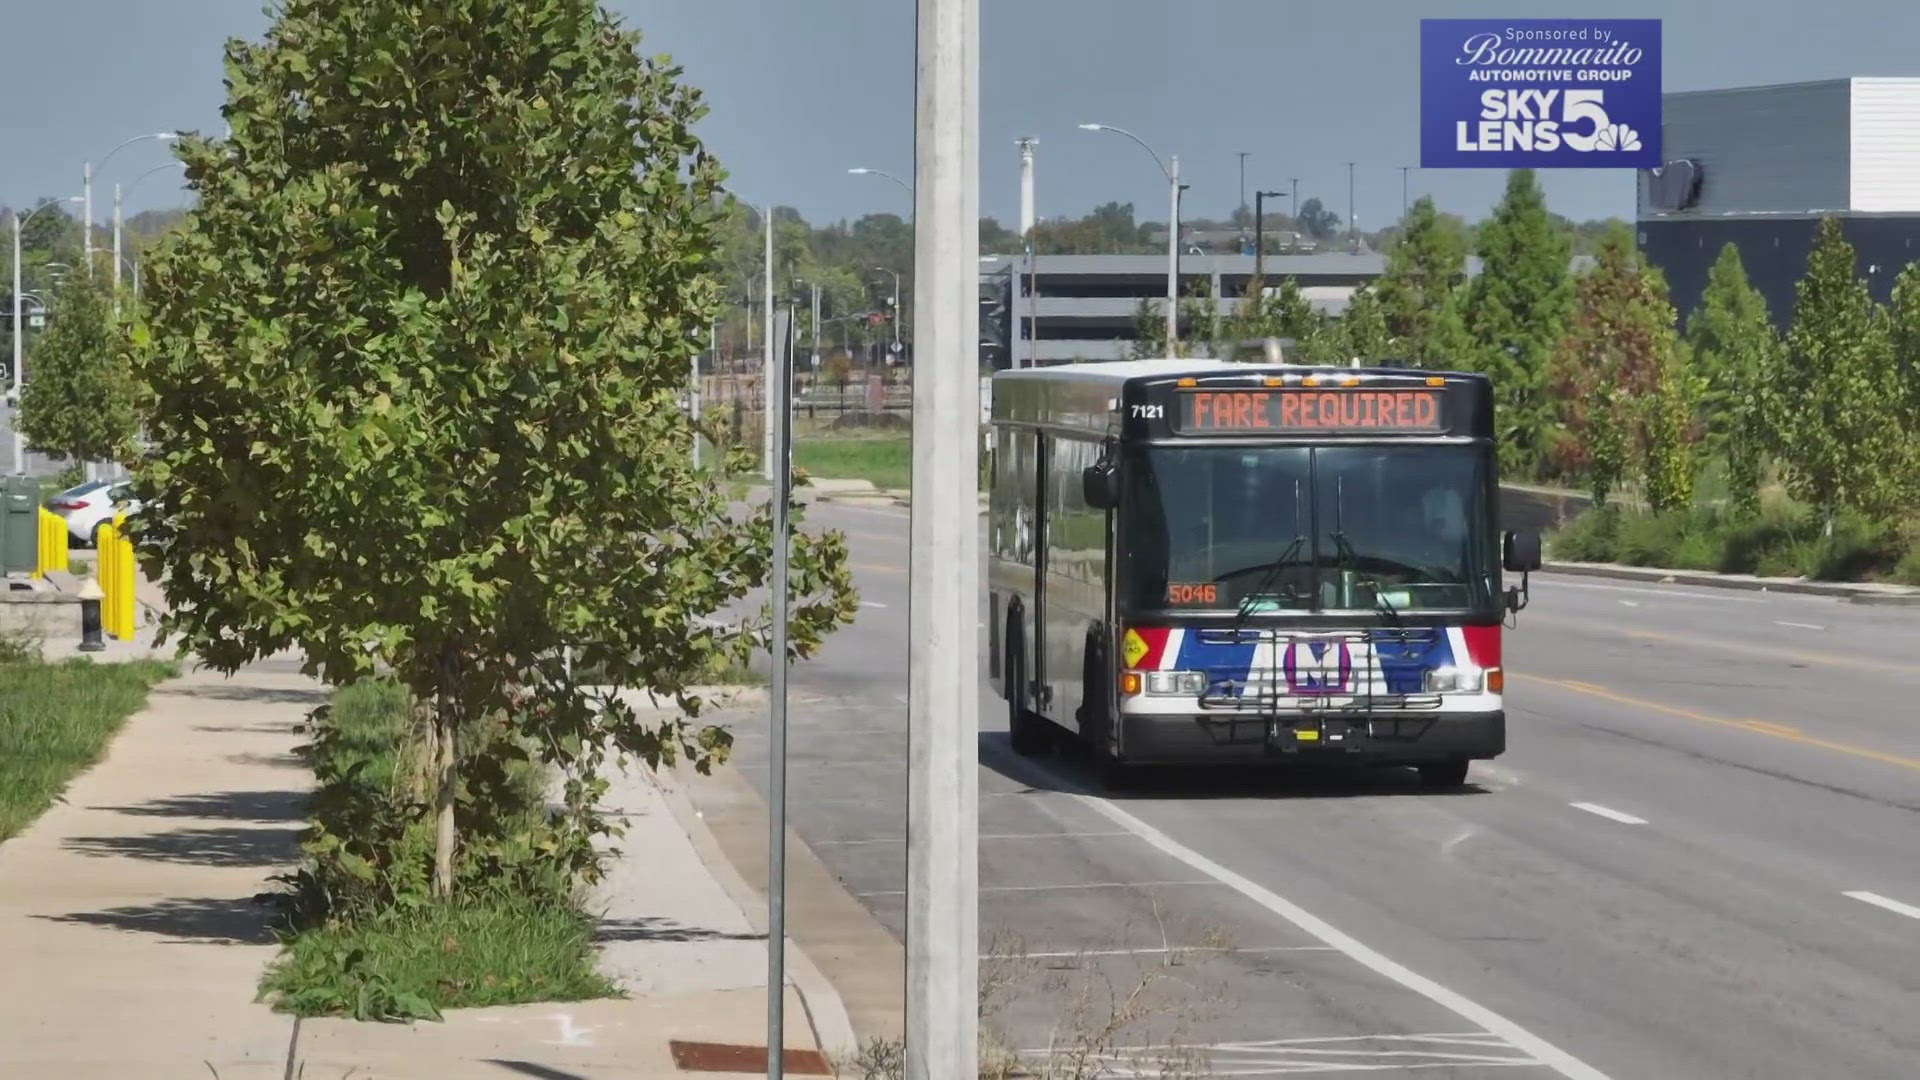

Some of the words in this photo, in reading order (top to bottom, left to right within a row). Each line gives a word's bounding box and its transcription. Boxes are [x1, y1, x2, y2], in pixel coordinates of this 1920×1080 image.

[1131, 404, 1164, 419] 7121
[1194, 393, 1270, 427] FARE
[1281, 393, 1436, 427] REQUIRED
[1168, 584, 1216, 603] 5046
